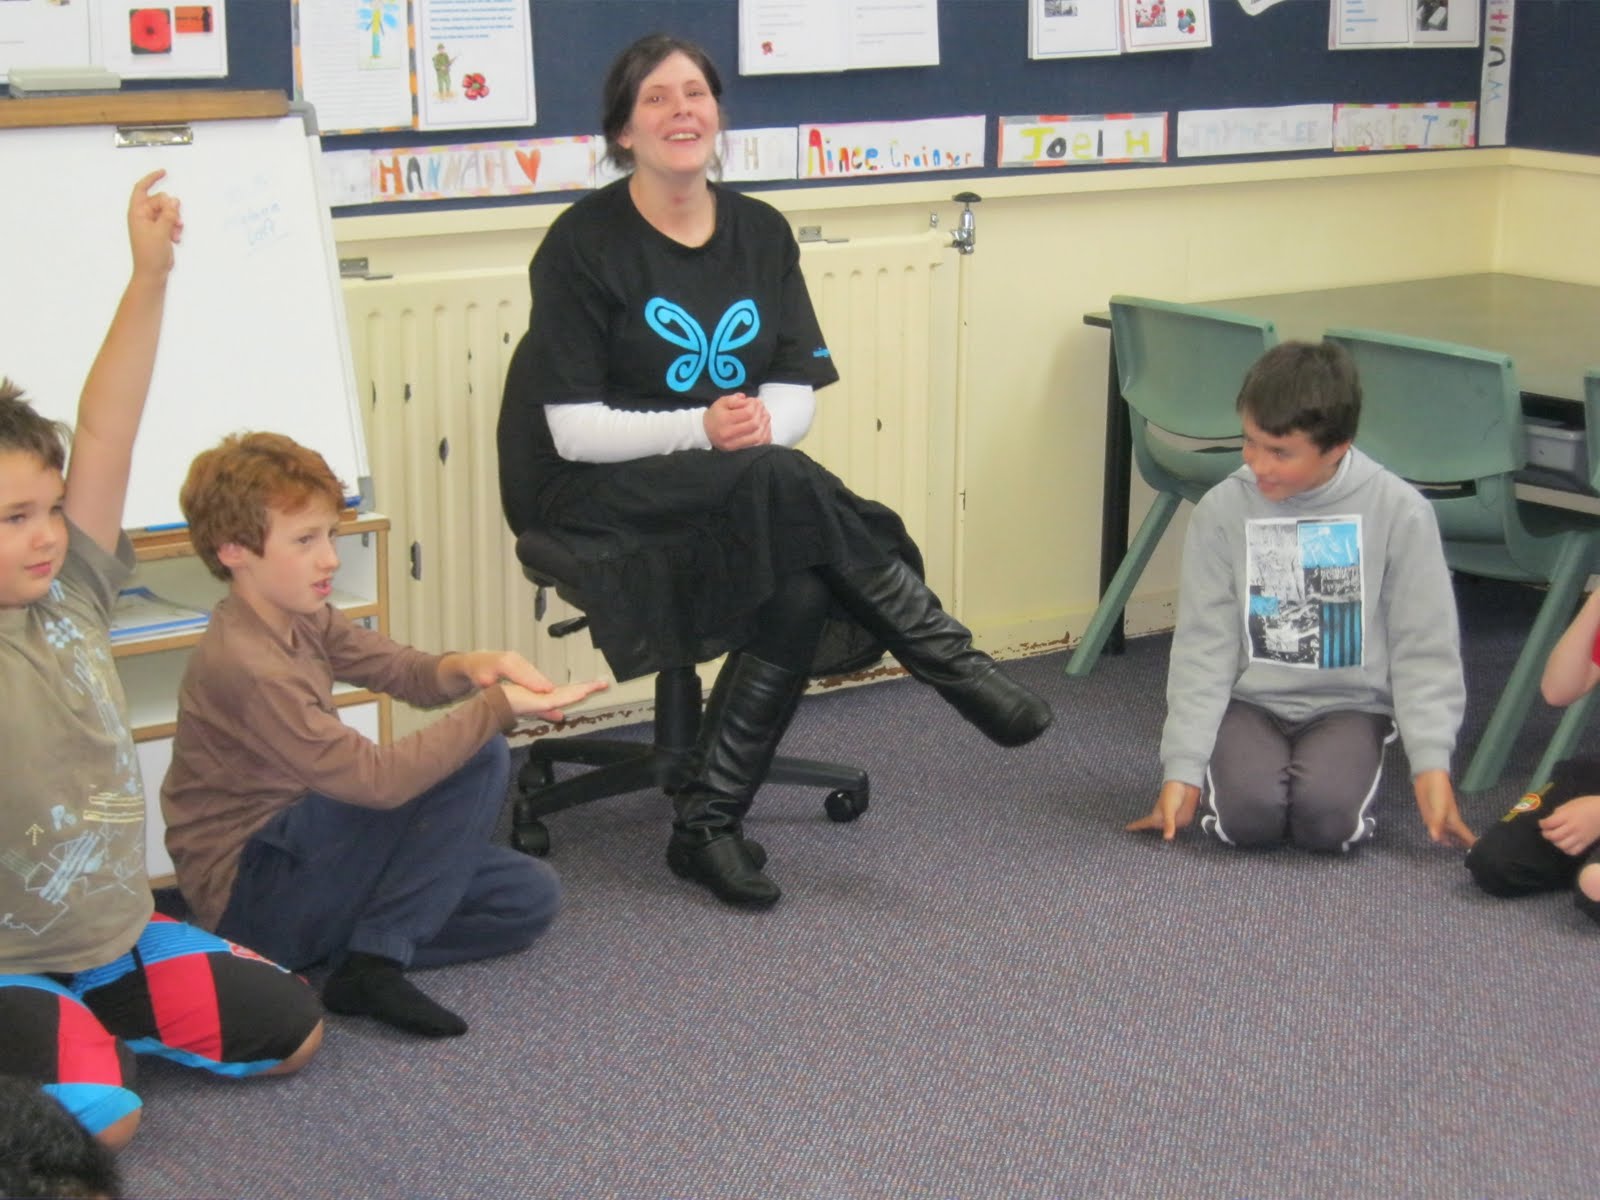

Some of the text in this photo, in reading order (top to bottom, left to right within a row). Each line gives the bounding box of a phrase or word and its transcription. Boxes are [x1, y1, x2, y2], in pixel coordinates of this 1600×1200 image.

[1019, 126, 1151, 161] Joel H
[378, 148, 511, 195] HANNAH
